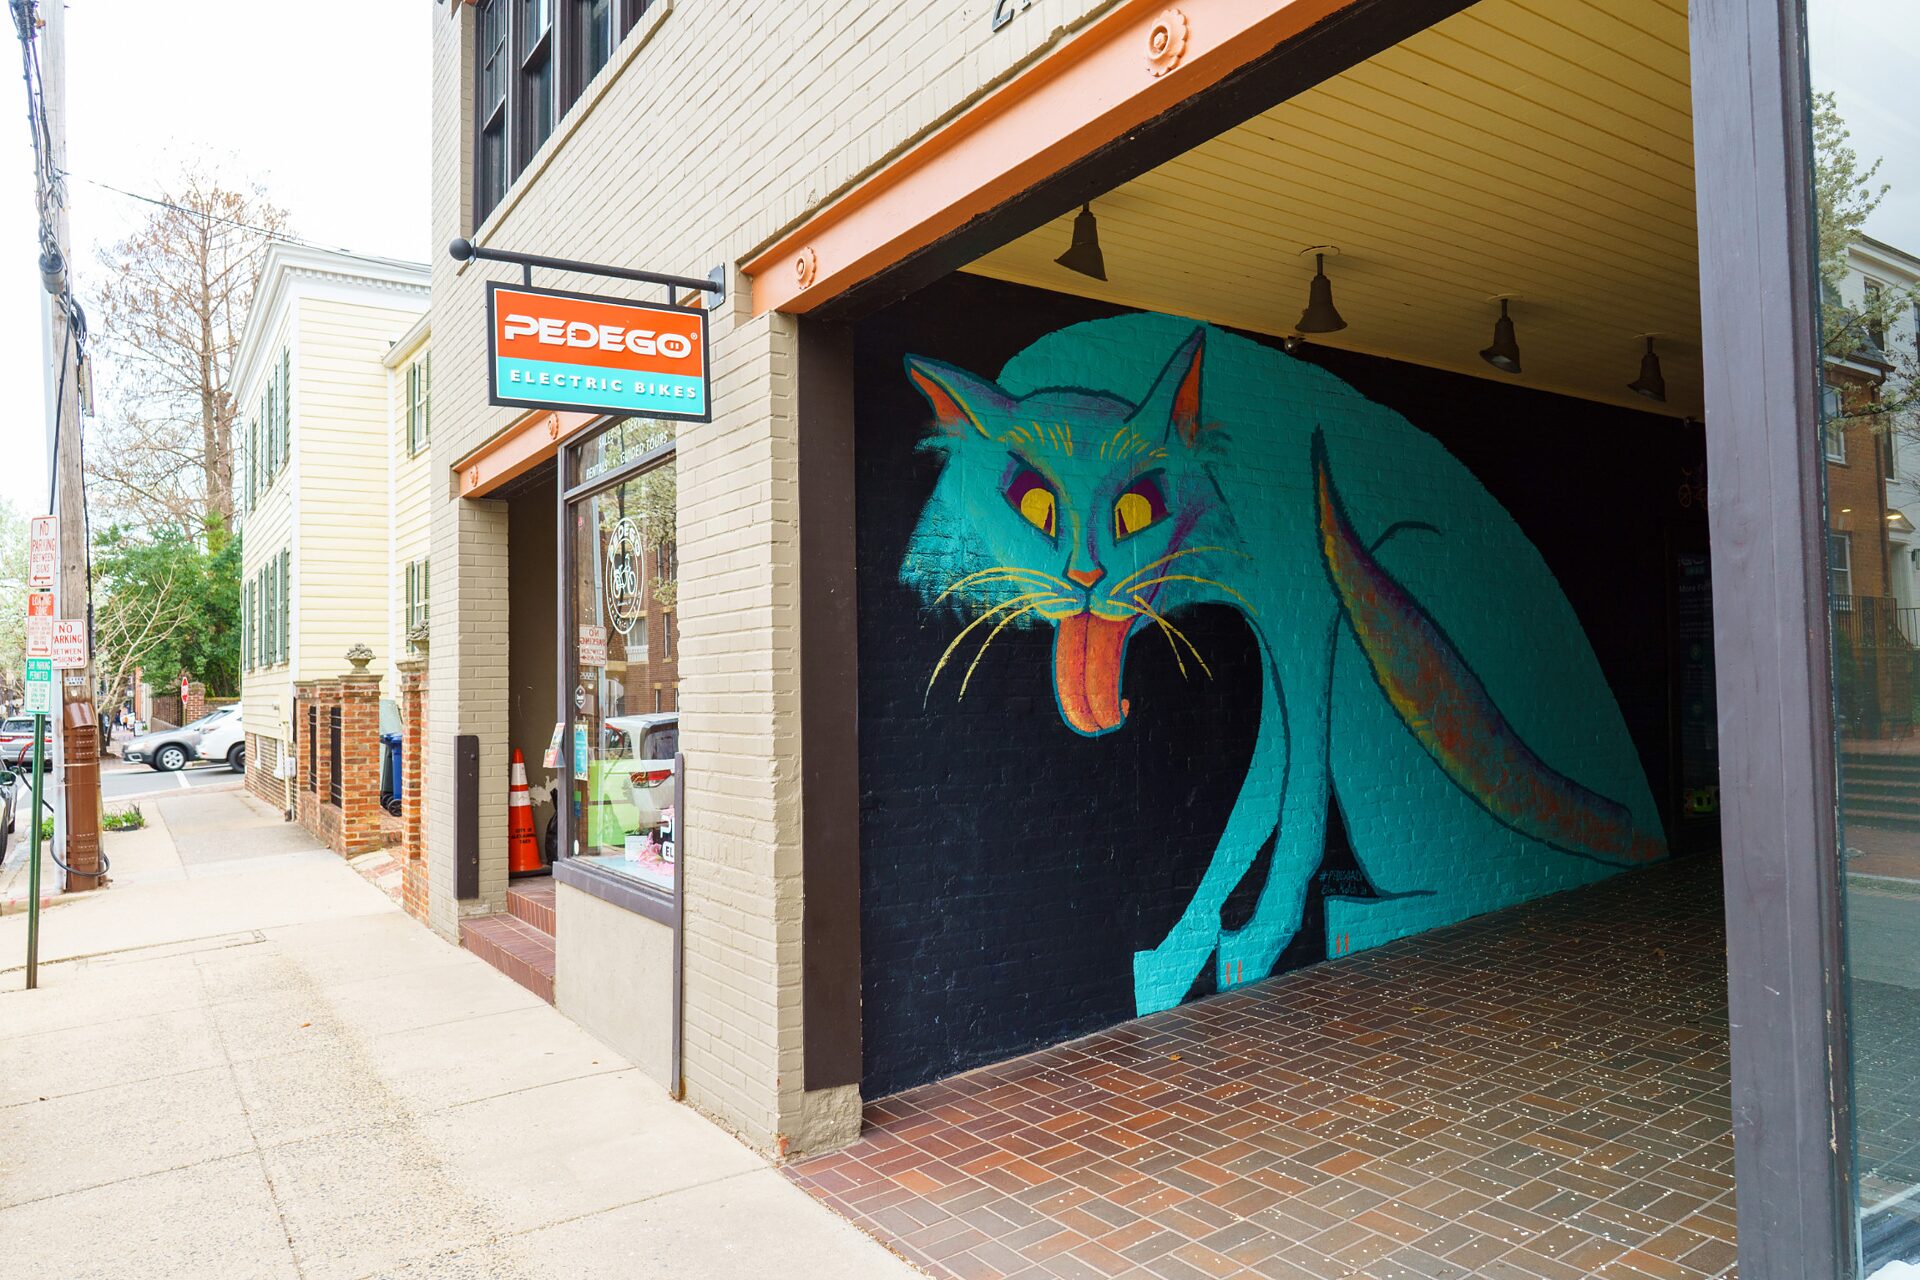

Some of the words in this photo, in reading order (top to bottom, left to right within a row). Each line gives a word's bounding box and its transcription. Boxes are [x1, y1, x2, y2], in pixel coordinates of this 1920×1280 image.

[504, 314, 692, 359] PEDEGO
[509, 369, 624, 392] ELECTRIC
[634, 382, 697, 399] BIKES
[586, 461, 608, 480] RENTALS
[620, 443, 644, 464] GUIDED
[646, 431, 668, 452] TOURS
[40, 522, 50, 536] NO
[54, 635, 82, 644] ARKING
[58, 624, 73, 633] NO
